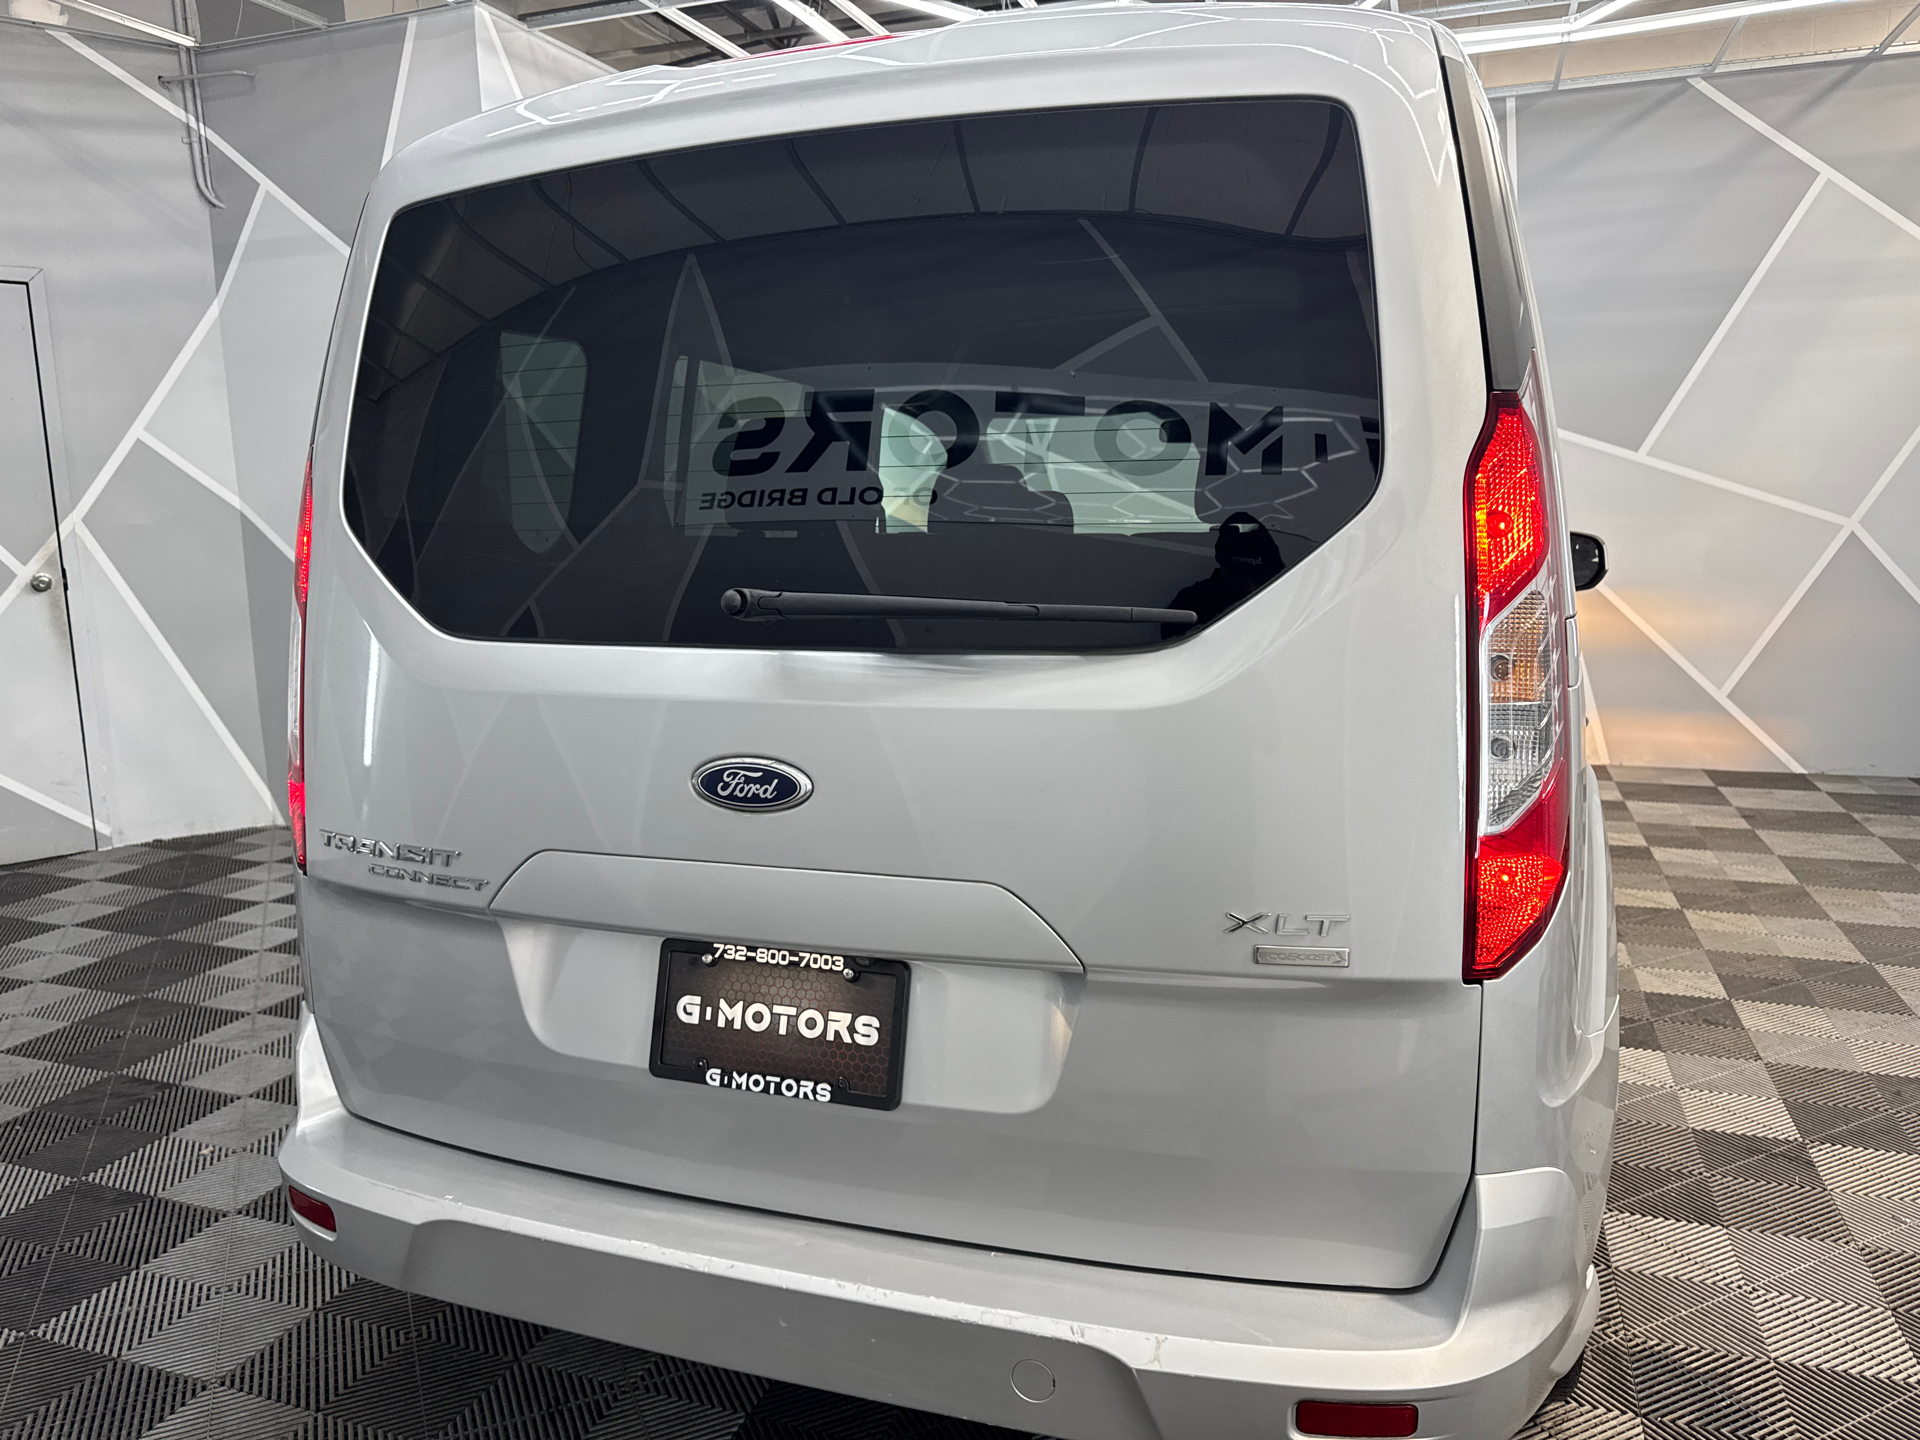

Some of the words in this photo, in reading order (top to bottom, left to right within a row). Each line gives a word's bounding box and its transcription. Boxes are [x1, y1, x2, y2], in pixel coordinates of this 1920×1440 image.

[717, 769, 779, 799] Ford
[319, 828, 462, 868] TRANSIT
[368, 863, 490, 892] CONNECT
[1223, 911, 1350, 937] XLT
[713, 943, 844, 972] 732-800-7003
